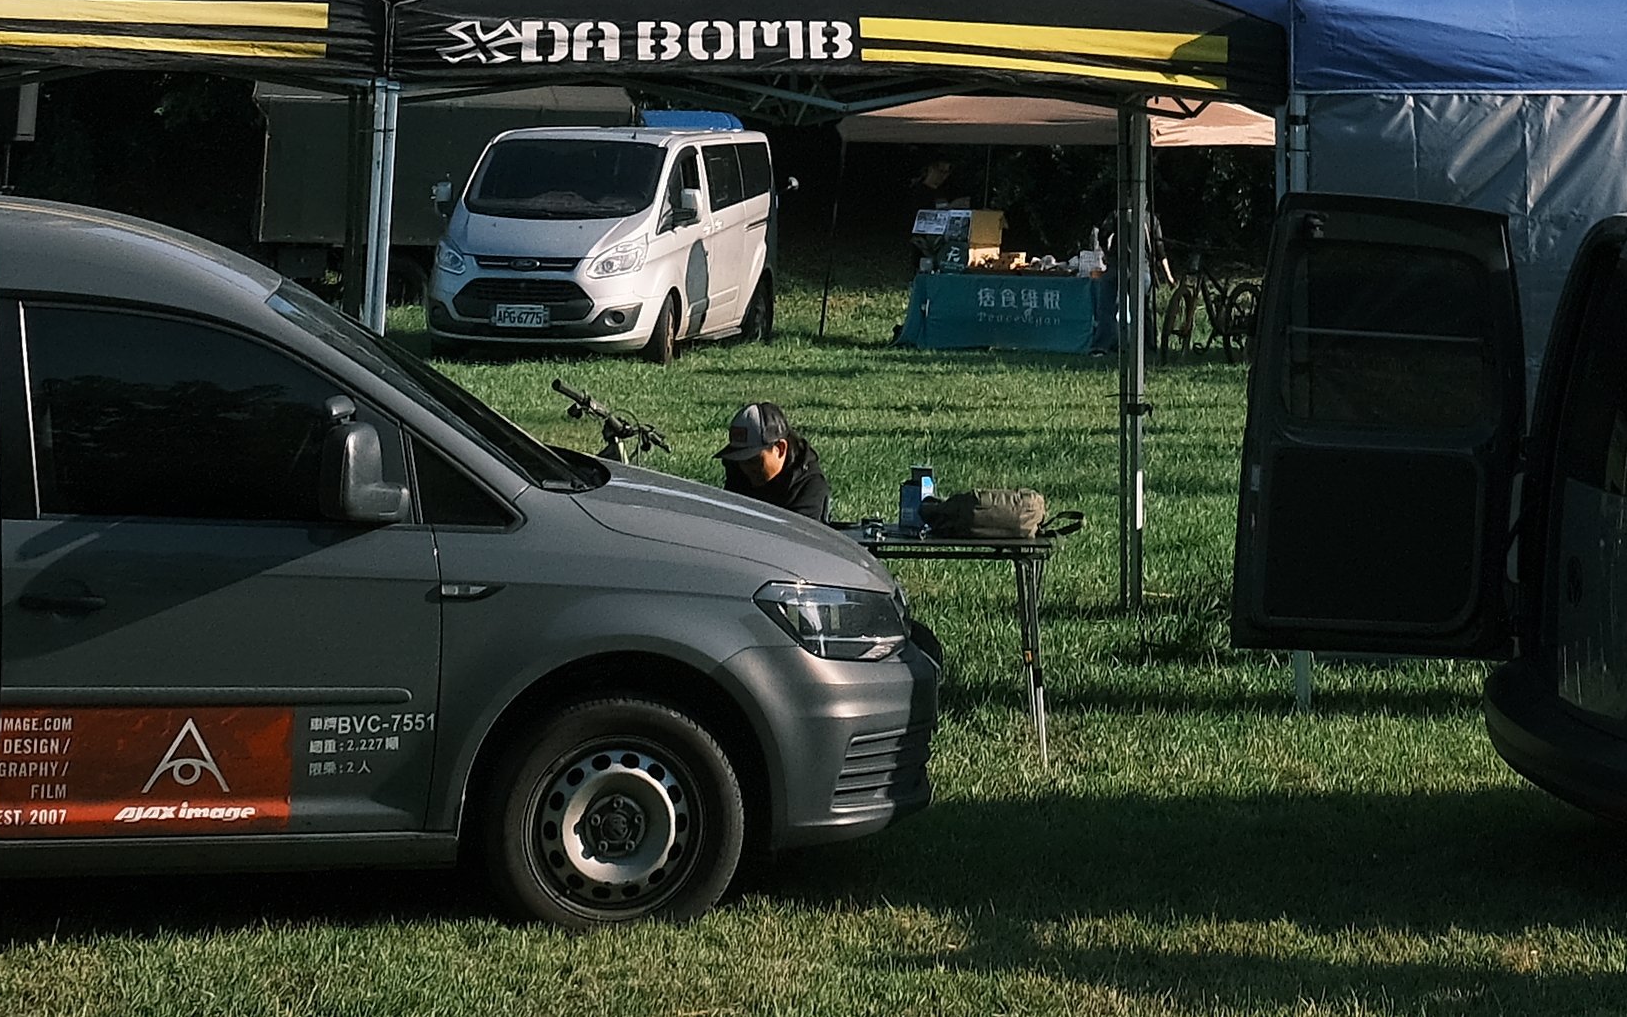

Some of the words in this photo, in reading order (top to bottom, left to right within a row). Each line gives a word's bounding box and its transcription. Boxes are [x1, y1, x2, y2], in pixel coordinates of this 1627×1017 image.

[520, 19, 621, 64] DA
[636, 19, 854, 62] BOMB
[30, 784, 68, 800] FILM
[29, 809, 68, 825] 2007
